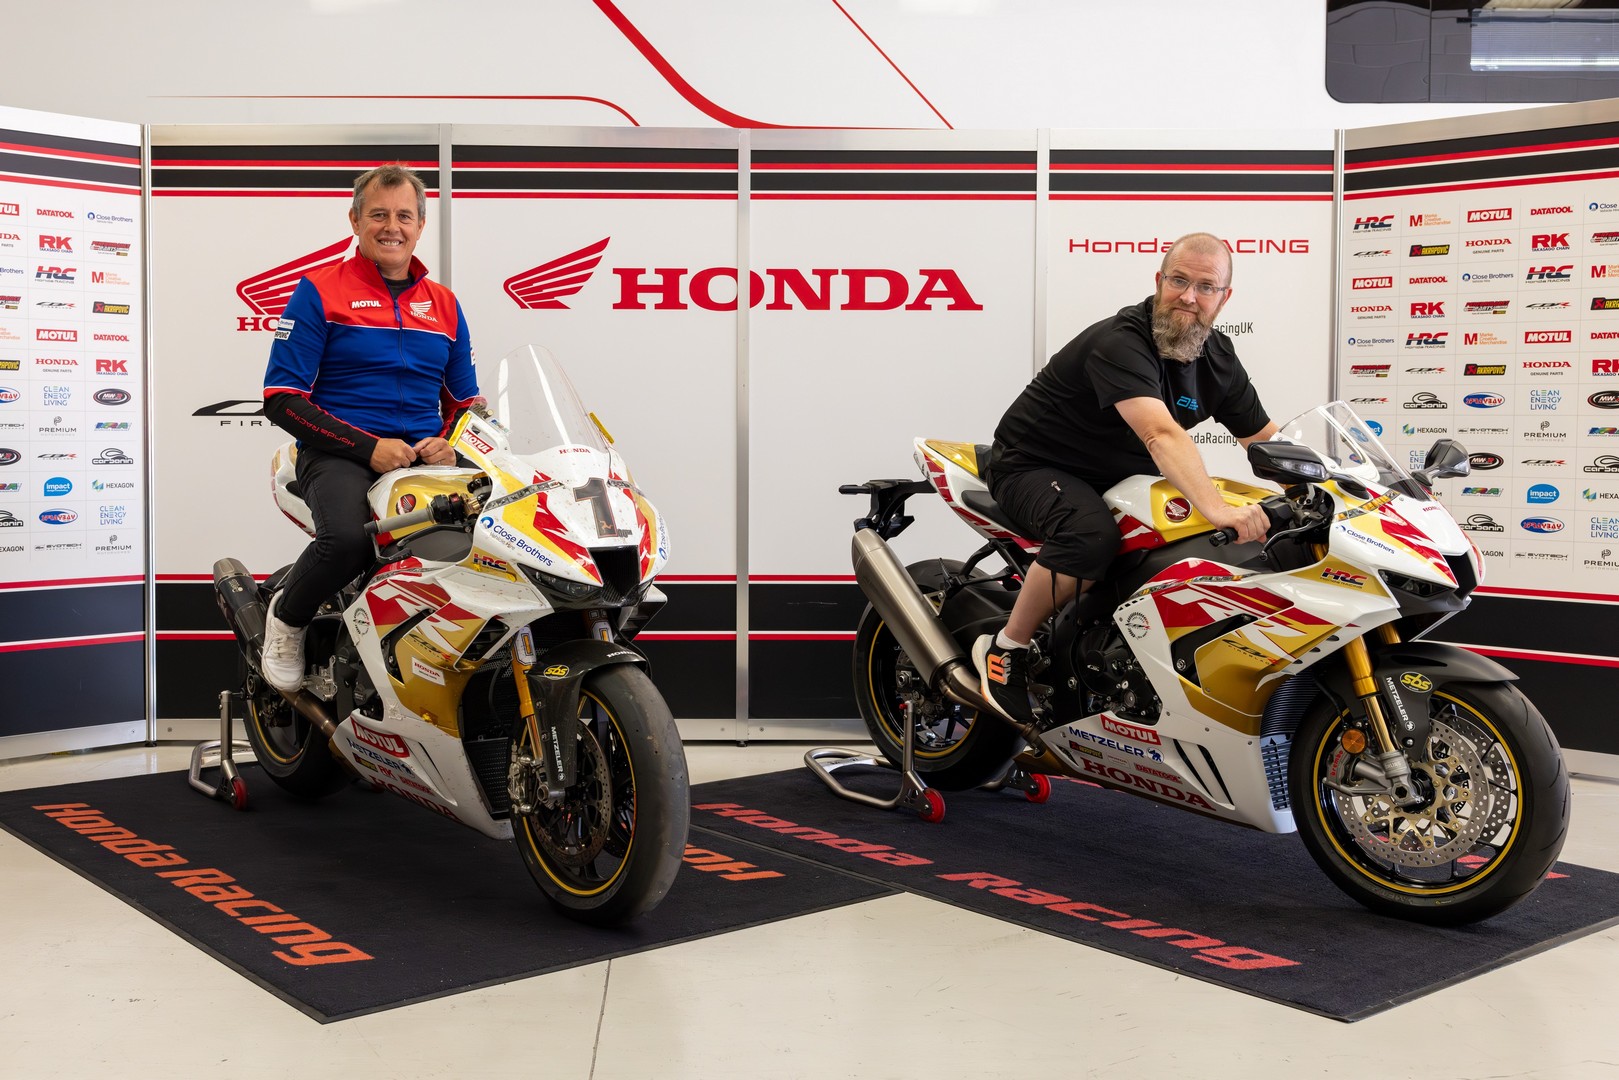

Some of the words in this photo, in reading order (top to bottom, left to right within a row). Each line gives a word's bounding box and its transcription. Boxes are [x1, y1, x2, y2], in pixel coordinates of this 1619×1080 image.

[37, 209, 74, 218] DATATOOL
[1469, 210, 1510, 221] MOTUL
[1530, 206, 1573, 216] DATATOOL
[1353, 215, 1395, 230] HRC
[39, 235, 73, 250] RK
[1465, 238, 1512, 247] HONDA
[1531, 233, 1570, 249] RK
[35, 265, 77, 280] HRC
[1409, 276, 1448, 284] DATATOOL
[1526, 265, 1574, 280] HRC
[612, 267, 983, 311] HONDA
[1353, 278, 1391, 288] MOTUL
[351, 300, 382, 309] MOTUL
[1351, 305, 1393, 313] HONDA
[1410, 301, 1445, 316] RK
[410, 310, 438, 322] HONDA
[38, 330, 76, 341] MOTUL
[1405, 332, 1449, 345] HRC
[1527, 332, 1570, 342] MOTUL
[35, 358, 79, 366] HONDA
[96, 359, 128, 373] RK
[1522, 361, 1572, 369] HONDA
[285, 408, 319, 433] RACING
[320, 428, 355, 447] Honda
[461, 431, 492, 454] MOTUL
[1530, 490, 1557, 498] impact
[573, 477, 618, 539] 1
[1346, 529, 1366, 541] Close
[1366, 537, 1395, 555] Brothers
[1591, 531, 1619, 539] LIVING
[493, 525, 517, 543] Close
[516, 539, 553, 567] Brothers
[473, 553, 507, 571] HRC
[1321, 566, 1368, 586] HRC
[414, 662, 440, 677] HONDA
[1386, 677, 1409, 722] METZELER
[354, 721, 405, 754] MOTUL
[1104, 721, 1157, 743] MOTUL
[550, 726, 563, 773] METZELER
[1069, 726, 1144, 758] METZELER
[1331, 750, 1344, 777] brembo
[1080, 757, 1217, 811] HONDA
[32, 802, 190, 868] Honda
[155, 867, 375, 966] Racing
[690, 803, 935, 867] Honda
[935, 872, 1302, 970] Racing
